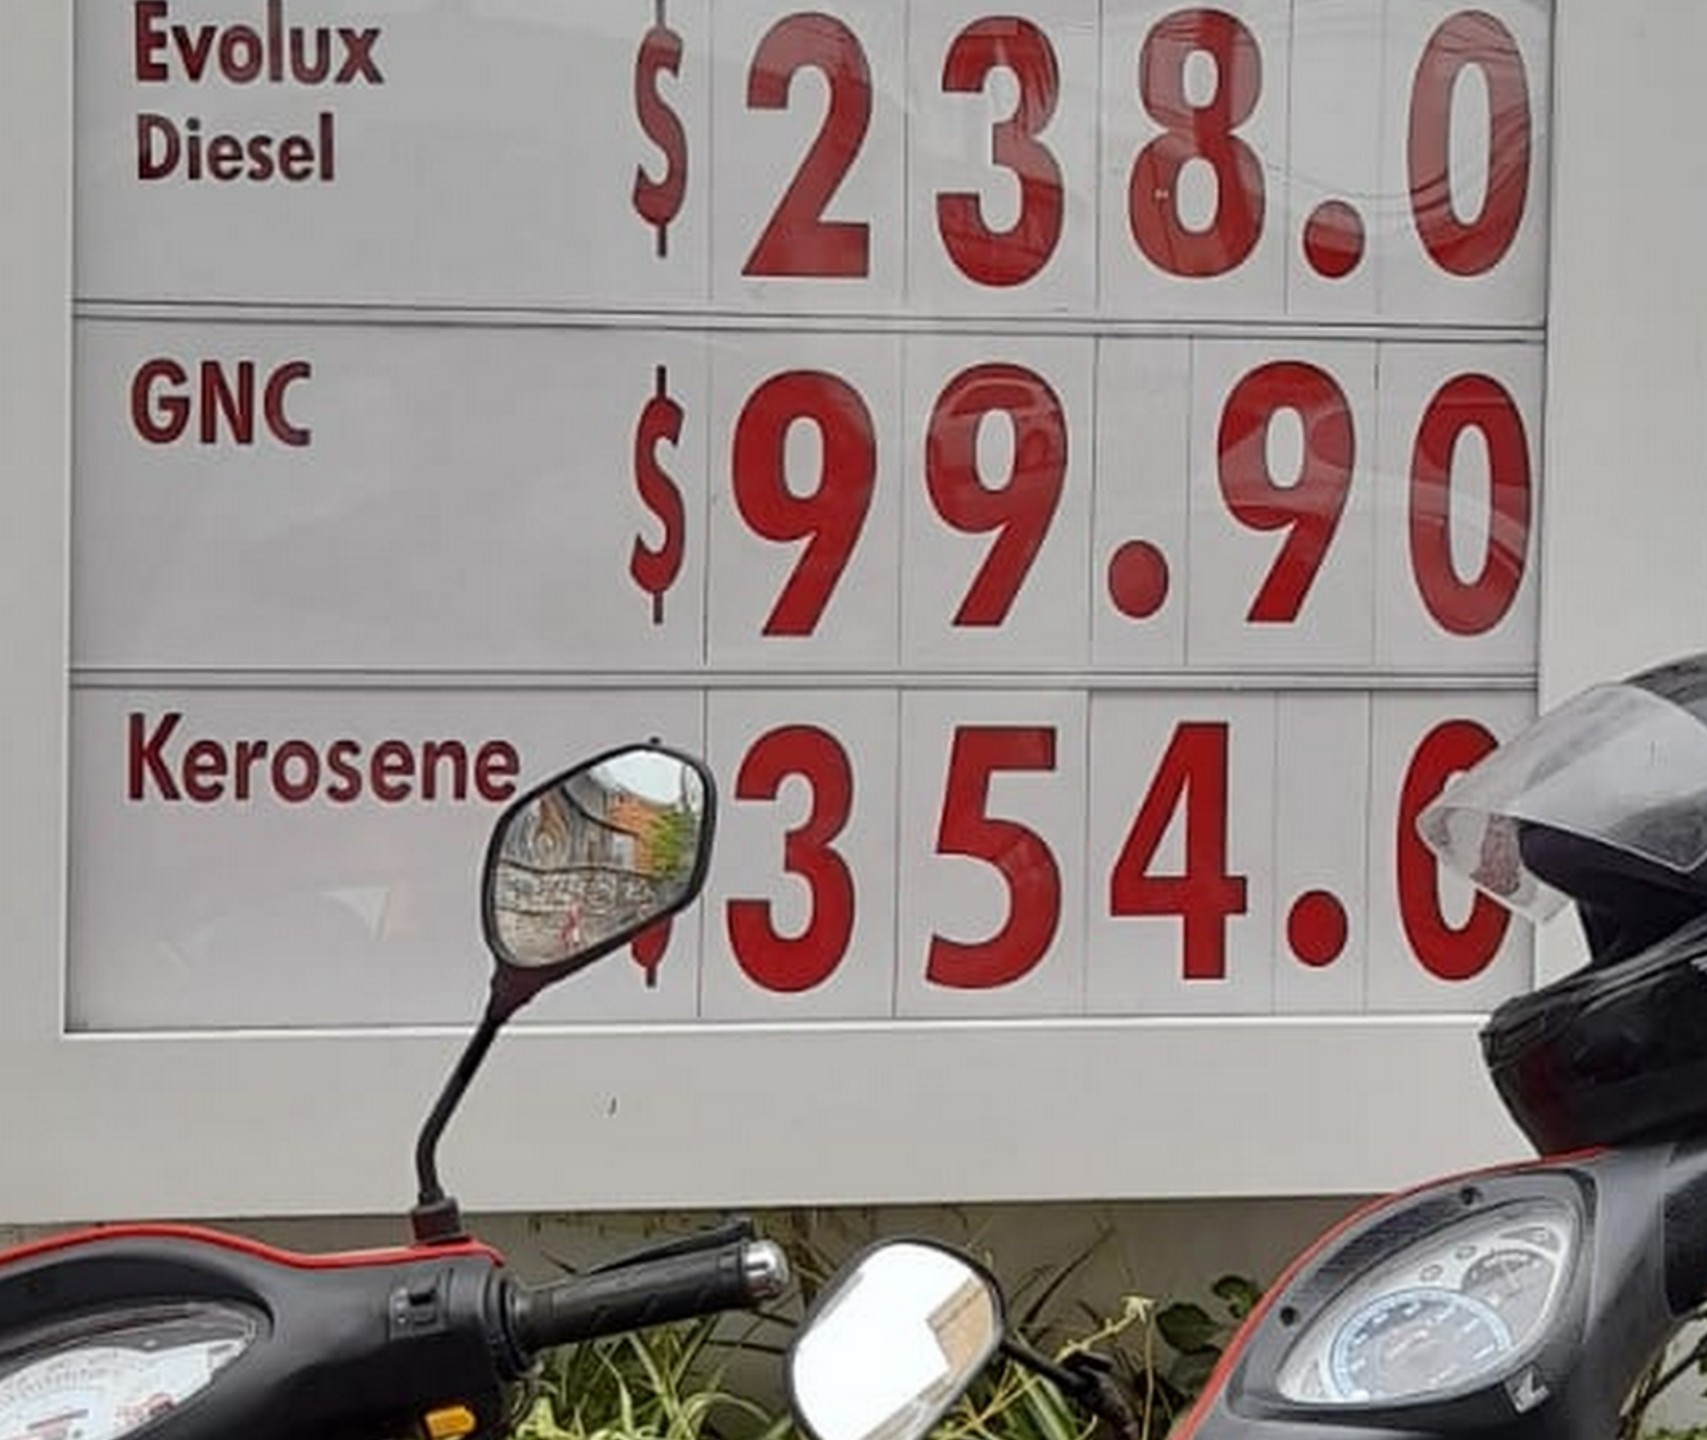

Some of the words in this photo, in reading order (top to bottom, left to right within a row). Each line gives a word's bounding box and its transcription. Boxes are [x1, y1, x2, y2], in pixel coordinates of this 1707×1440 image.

[137, 112, 335, 183] Diesel
[131, 358, 312, 447] GNC
[125, 712, 521, 806] Kerosene
